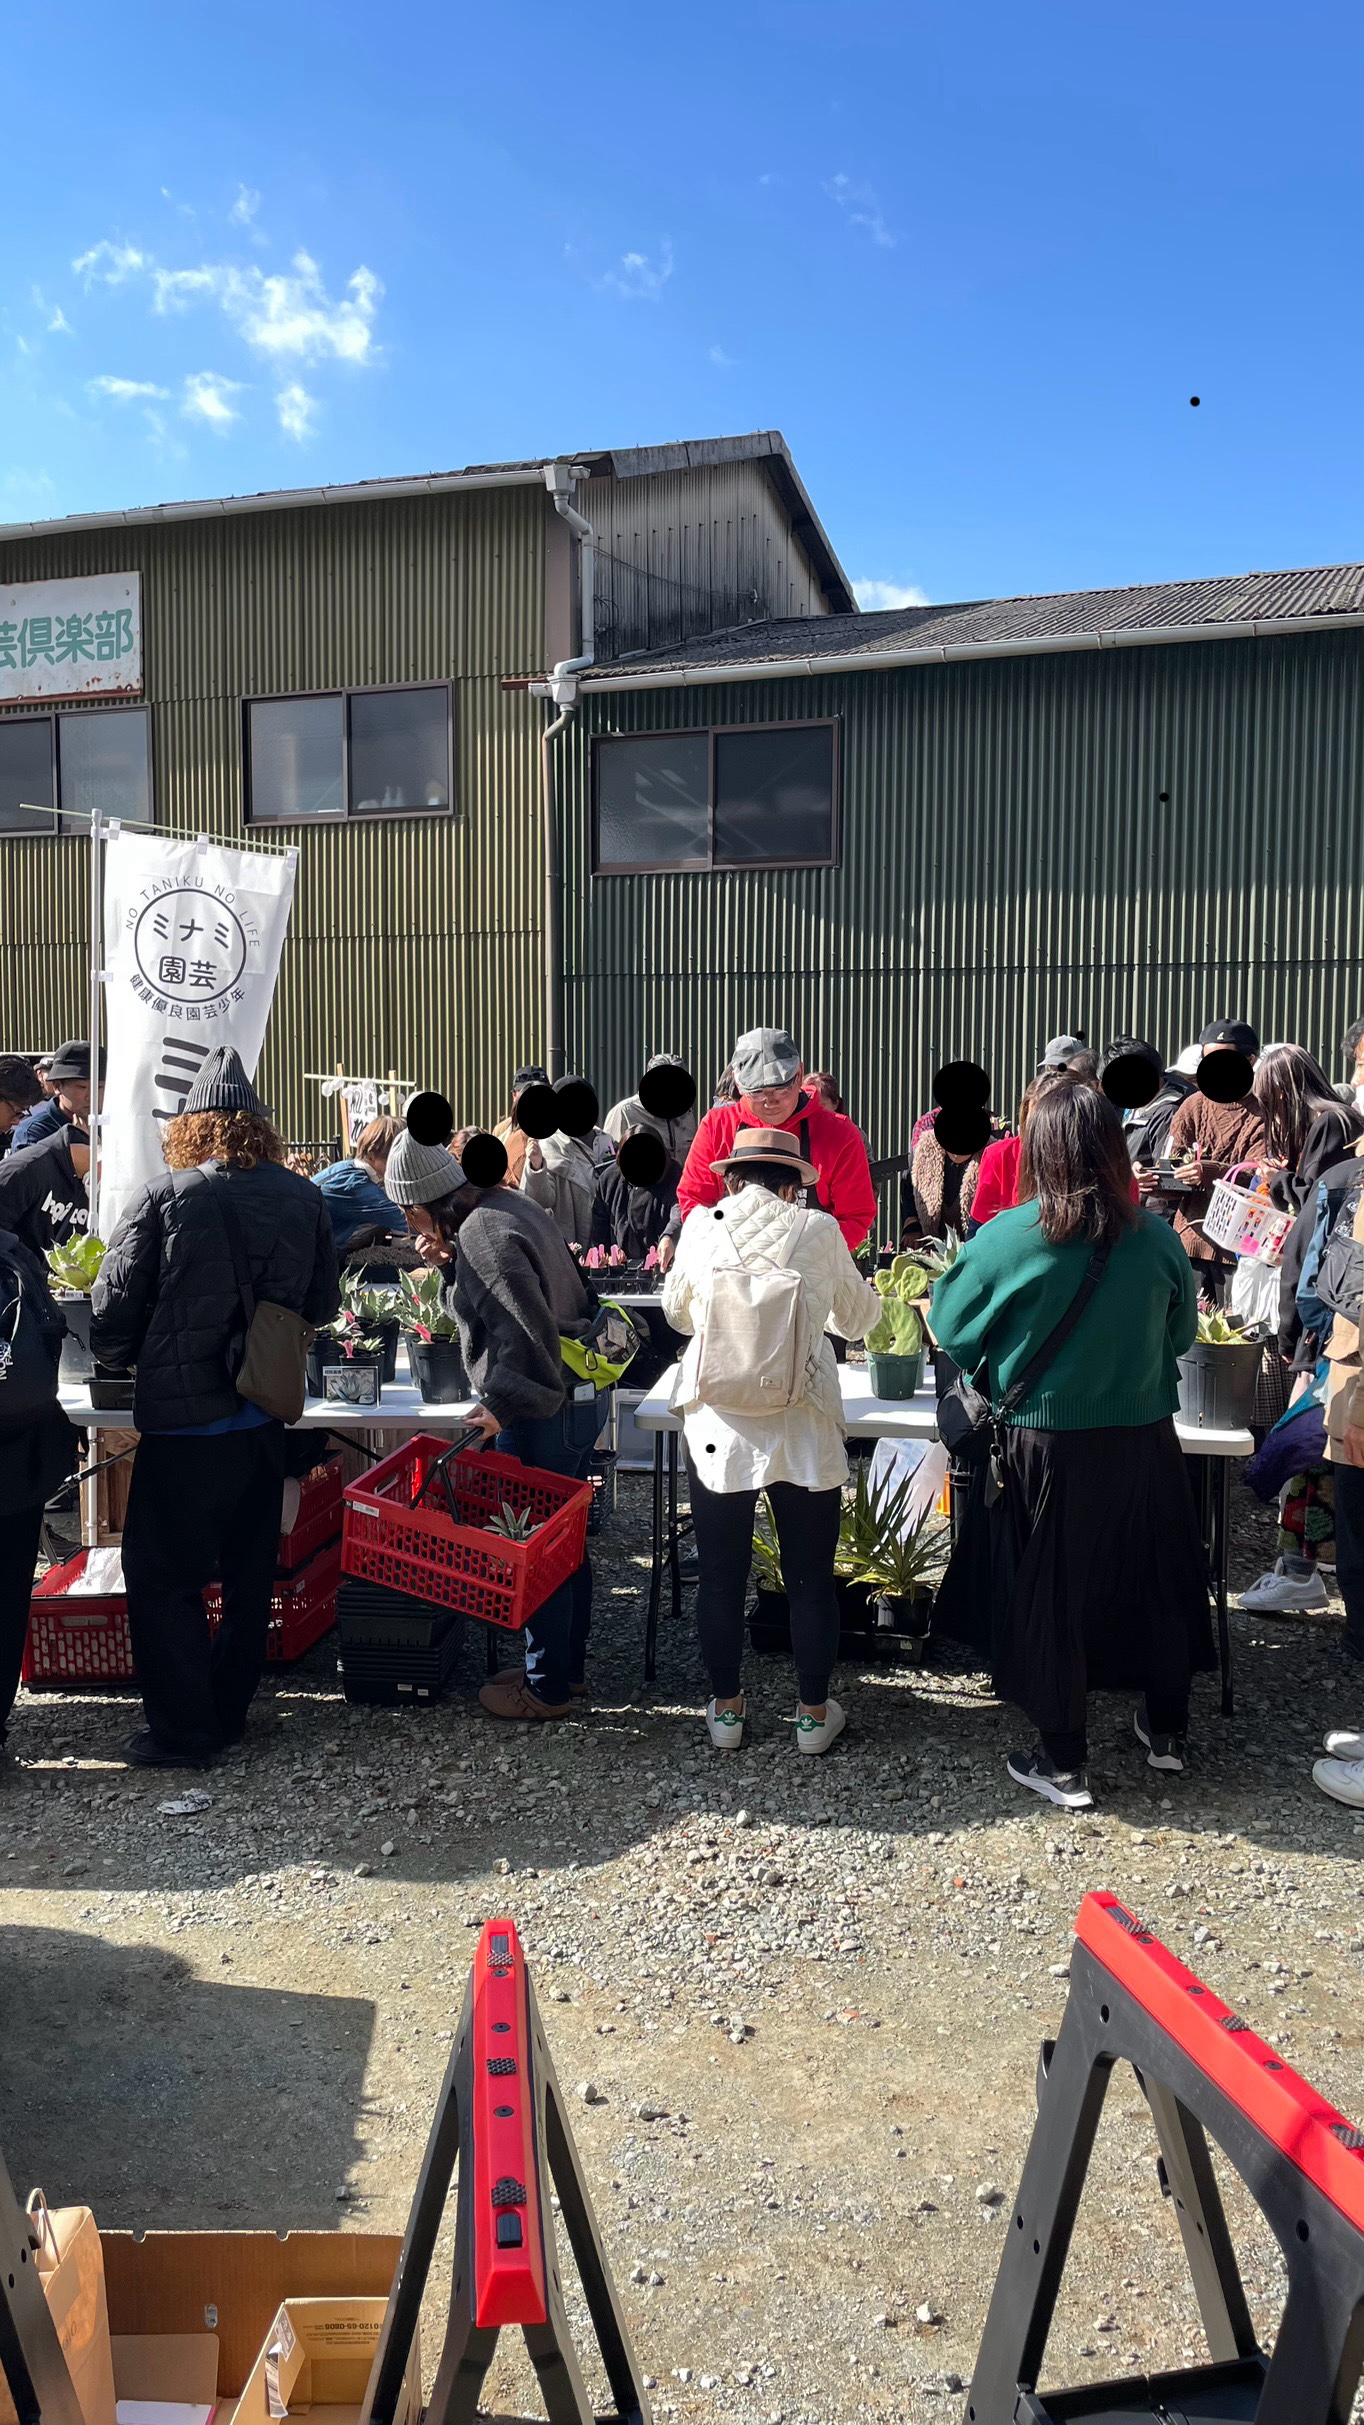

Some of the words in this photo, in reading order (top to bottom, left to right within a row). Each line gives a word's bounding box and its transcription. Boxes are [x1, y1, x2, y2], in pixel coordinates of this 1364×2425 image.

[126, 908, 138, 930] NO
[140, 876, 204, 900] TANIKU
[214, 885, 235, 904] NO
[239, 911, 260, 947] LIFE
[153, 913, 229, 949] ミナミ
[159, 956, 217, 990] 園芸
[130, 974, 246, 1021] 健康優良園芸少年
